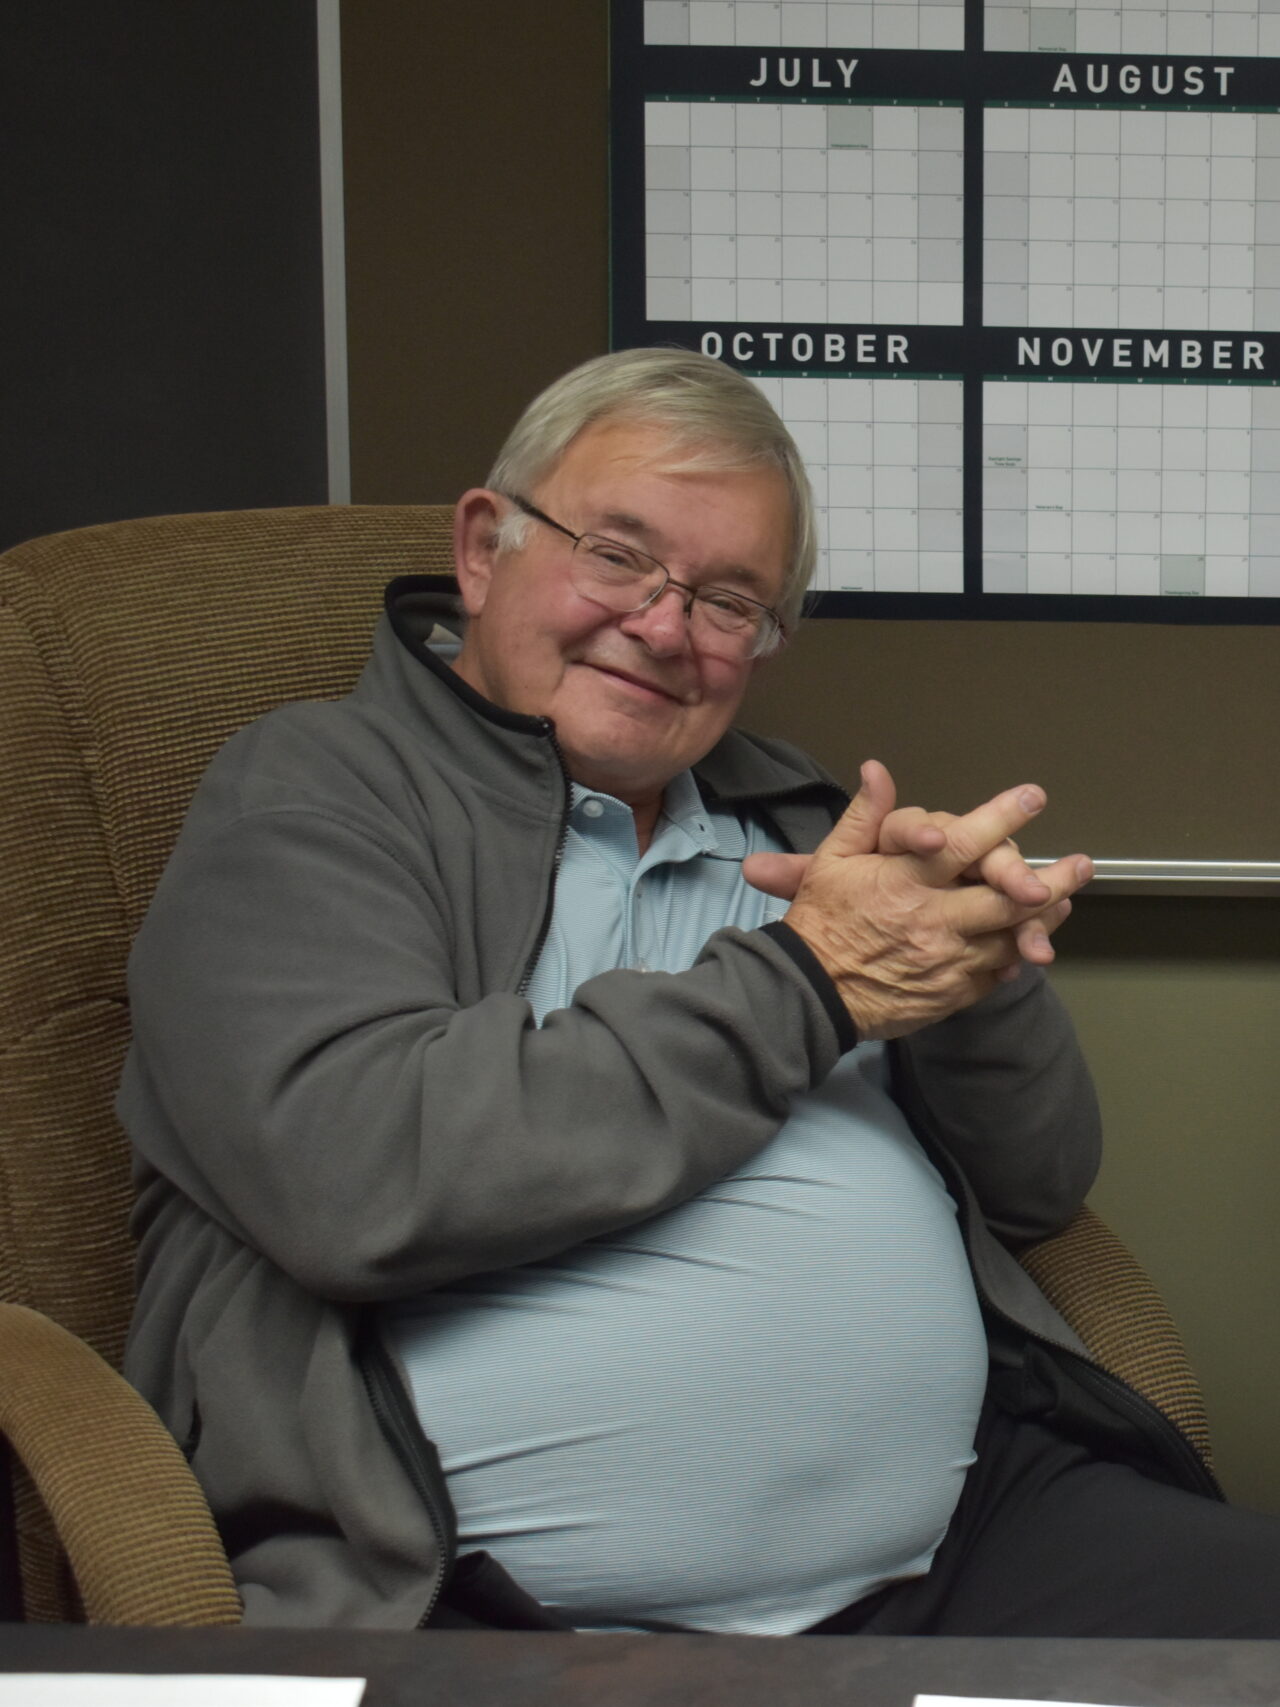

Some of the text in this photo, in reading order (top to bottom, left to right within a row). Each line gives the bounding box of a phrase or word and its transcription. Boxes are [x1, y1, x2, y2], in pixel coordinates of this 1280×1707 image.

[750, 58, 858, 87] JULY
[1053, 64, 1234, 95] AUGUST
[701, 331, 909, 364] OCTOBER
[1019, 337, 1264, 369] NOVEMBER
